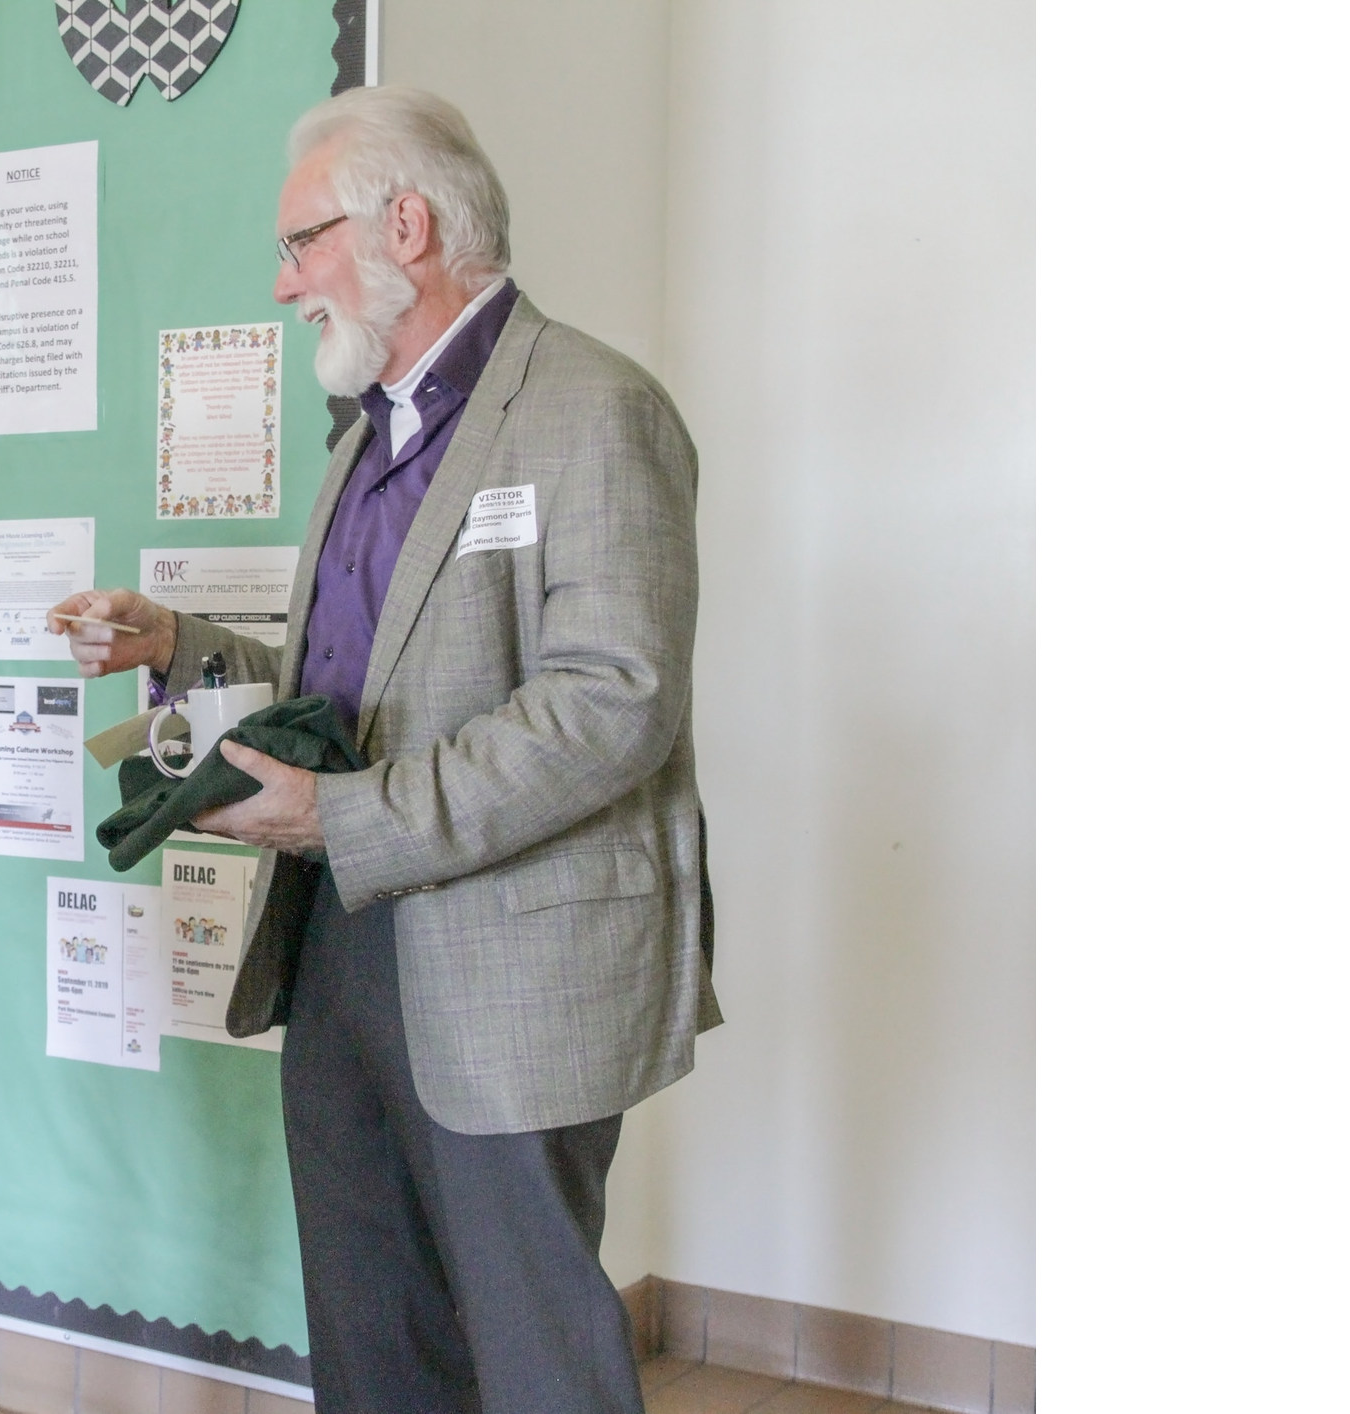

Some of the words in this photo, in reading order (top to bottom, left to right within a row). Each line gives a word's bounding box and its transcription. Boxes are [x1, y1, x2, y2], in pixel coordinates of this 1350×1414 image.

[6, 168, 41, 182] NOTICE
[6, 207, 23, 217] your
[25, 203, 46, 213] voice,
[48, 201, 68, 211] using
[15, 221, 23, 229] or
[25, 216, 68, 228] threatening
[12, 234, 32, 243] while
[34, 234, 44, 242] on
[46, 230, 70, 241] school
[25, 246, 58, 257] violation
[59, 245, 68, 253] of
[7, 264, 25, 273] Code
[26, 261, 52, 272] 32210,
[54, 258, 79, 270] 32211,
[11, 278, 31, 288] Penal
[32, 276, 52, 286] Code
[31, 308, 65, 320] presence
[66, 308, 77, 316] on
[78, 307, 83, 315] a
[22, 326, 29, 334] is
[36, 322, 69, 333] violation
[70, 321, 79, 330] of
[40, 337, 54, 347] and
[56, 337, 73, 348] may
[25, 353, 46, 364] being
[46, 351, 64, 362] filed
[65, 350, 83, 361] with
[28, 367, 54, 377] issued
[53, 366, 63, 377] by
[65, 366, 78, 375] the
[15, 382, 62, 394] Department.
[478, 490, 523, 503] VISITOR
[472, 513, 508, 524] Raymond
[510, 510, 532, 519] Parris
[472, 521, 502, 529] Classroom
[473, 538, 493, 546] Wind
[495, 535, 521, 544] School
[150, 585, 205, 594] COMMUNITY
[206, 585, 249, 593] ATHLETIC
[250, 584, 289, 595] PROJECT
[241, 614, 272, 622] SCHEDULE
[16, 746, 39, 754] Culture
[40, 746, 74, 757] Workshop
[173, 863, 216, 886] DELAC
[58, 891, 97, 911] DELAC
[186, 960, 214, 969] septiembre
[58, 976, 86, 987] September
[94, 981, 109, 990] 2019
